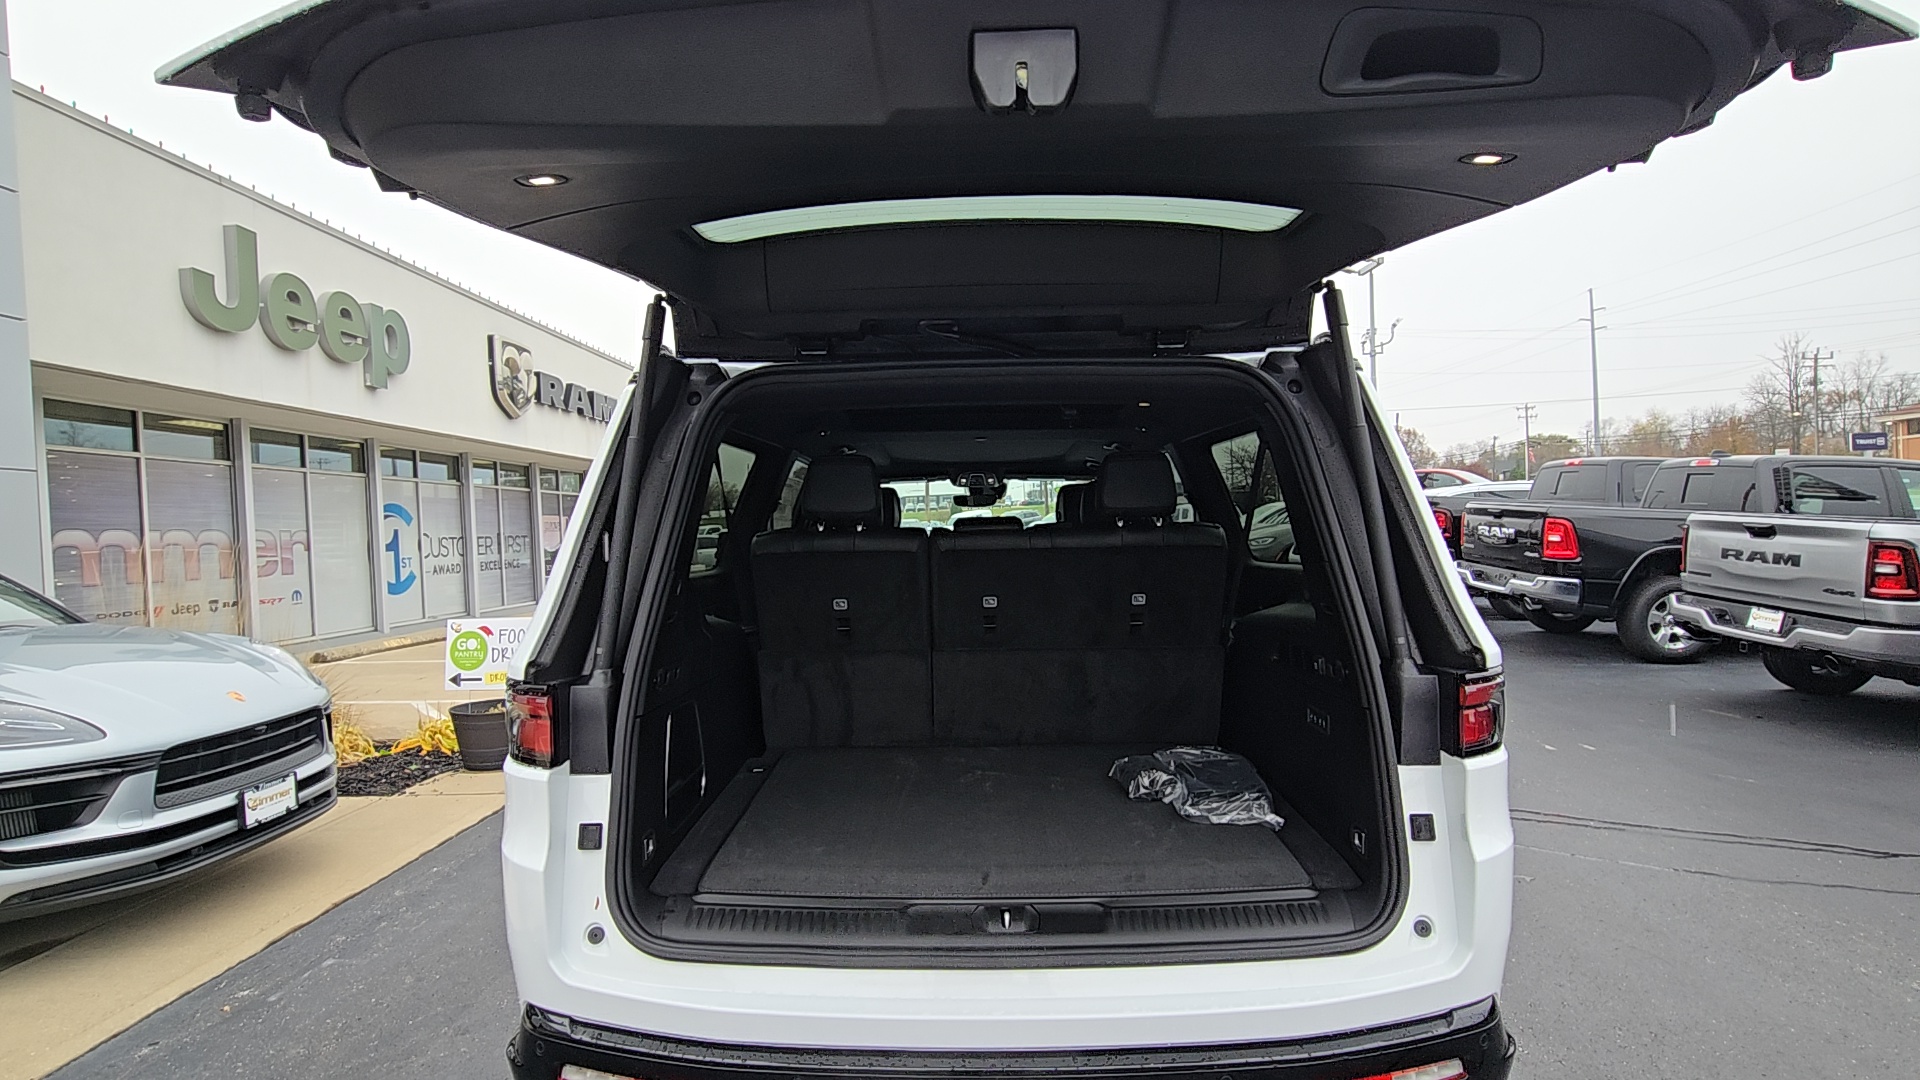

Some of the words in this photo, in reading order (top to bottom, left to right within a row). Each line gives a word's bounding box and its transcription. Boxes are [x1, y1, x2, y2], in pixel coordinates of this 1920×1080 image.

[179, 224, 410, 389] Jeep
[1477, 525, 1516, 539] RAM
[1720, 547, 1802, 567] RAM
[433, 563, 462, 576] AWARD
[171, 602, 200, 616] Jeep
[498, 628, 526, 644] FOO
[456, 638, 481, 651] GO!
